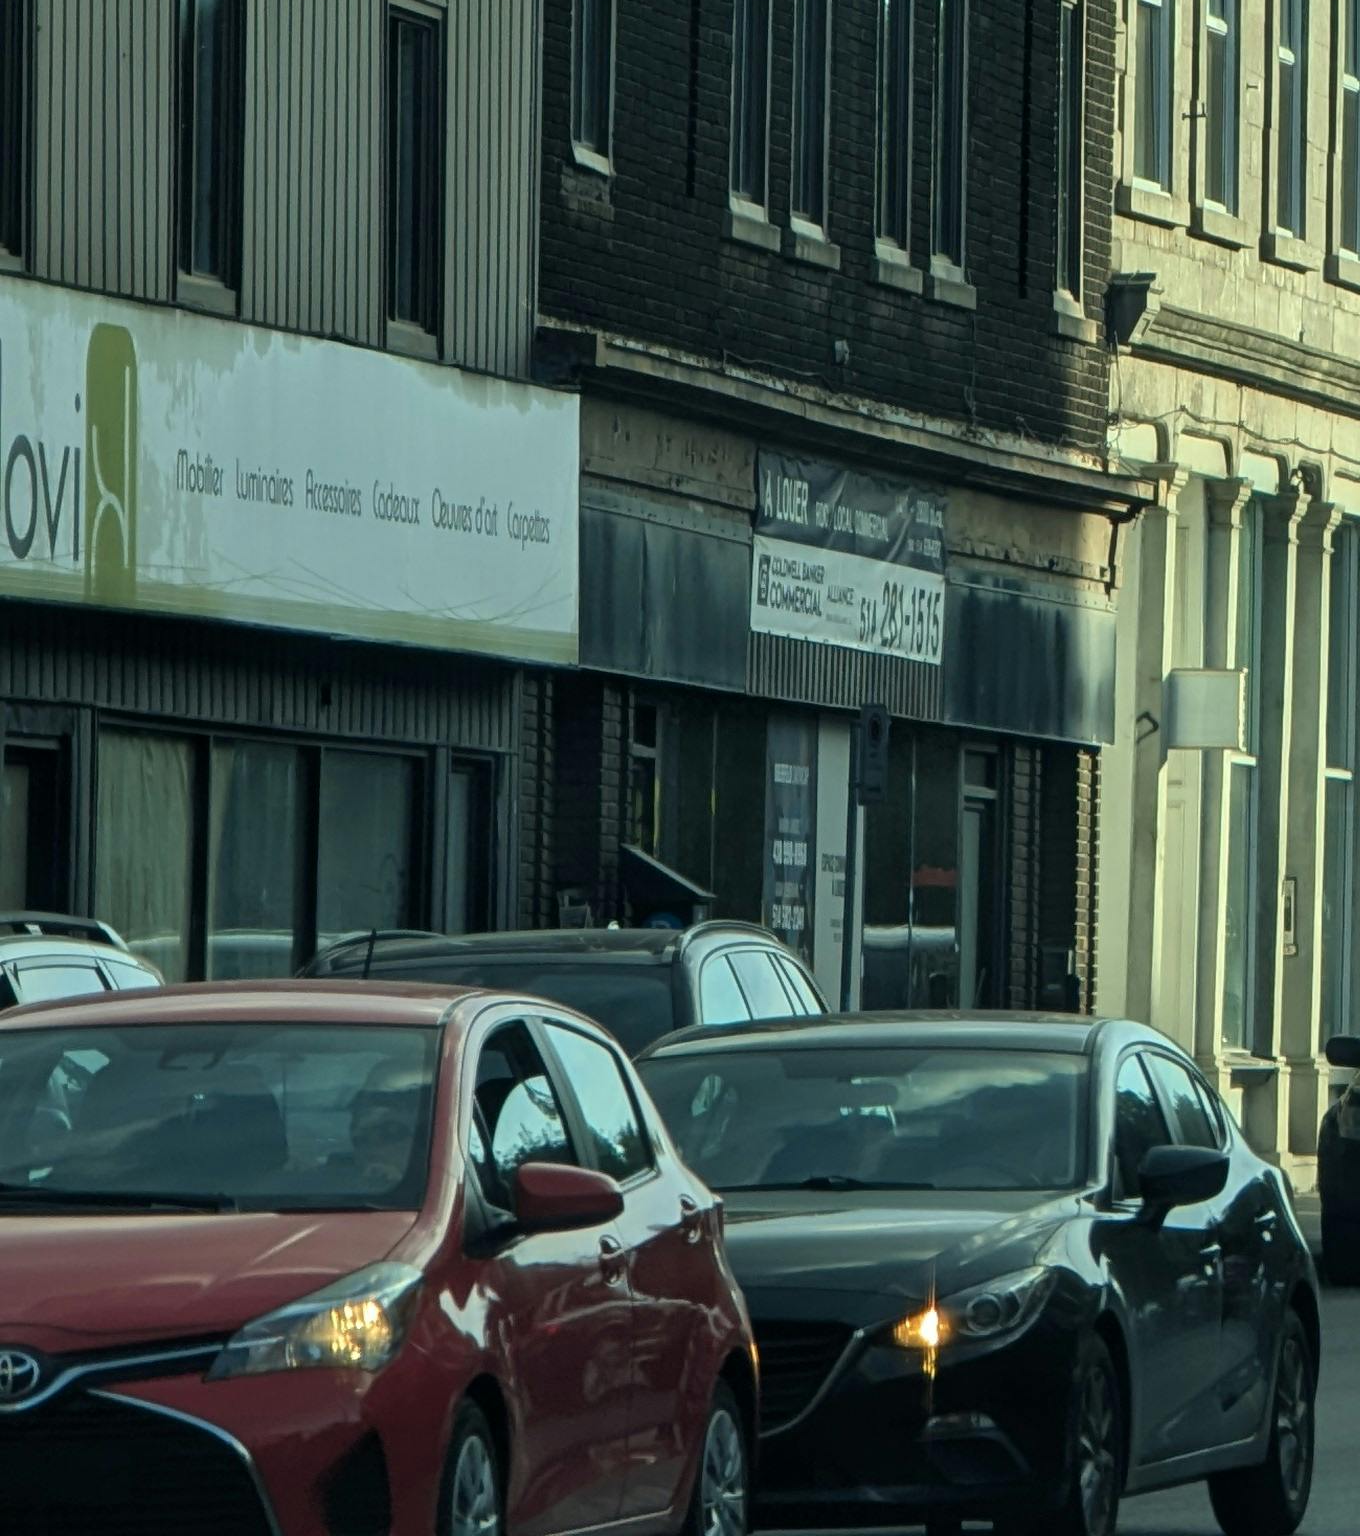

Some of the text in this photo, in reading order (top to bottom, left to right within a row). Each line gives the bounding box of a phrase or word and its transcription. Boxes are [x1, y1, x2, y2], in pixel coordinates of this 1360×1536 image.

[177, 448, 224, 496] Mobilier
[305, 468, 361, 517] Accessoires
[373, 479, 420, 525] Cadeaux
[432, 487, 473, 533] Oeuvres
[475, 496, 498, 536] d'art
[508, 501, 550, 551] Carpettes
[776, 474, 809, 526] LOUER
[769, 581, 822, 617] COMMERCIAL
[880, 580, 941, 656] 281-1515
